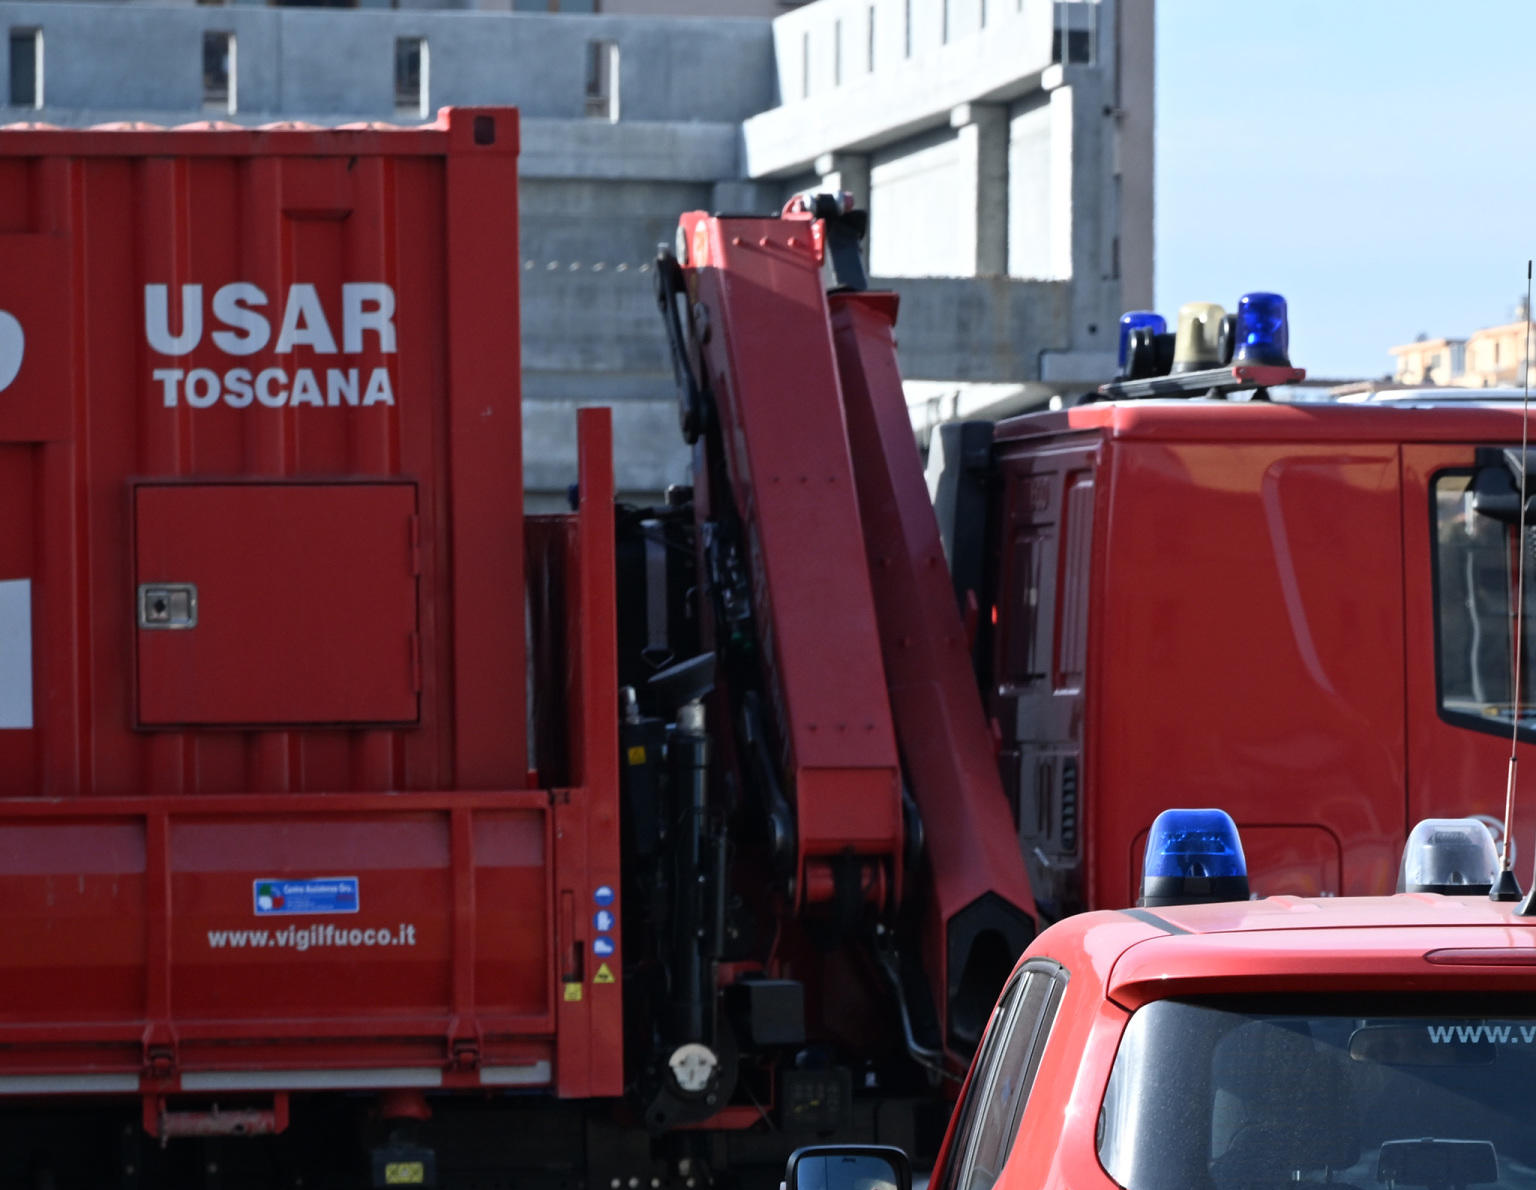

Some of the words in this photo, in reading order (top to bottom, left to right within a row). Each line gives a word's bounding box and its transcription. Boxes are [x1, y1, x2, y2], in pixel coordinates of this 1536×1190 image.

[143, 281, 397, 355] USAR
[153, 367, 396, 409] TOSCANA
[207, 922, 417, 951] www.vigilfuoco.it
